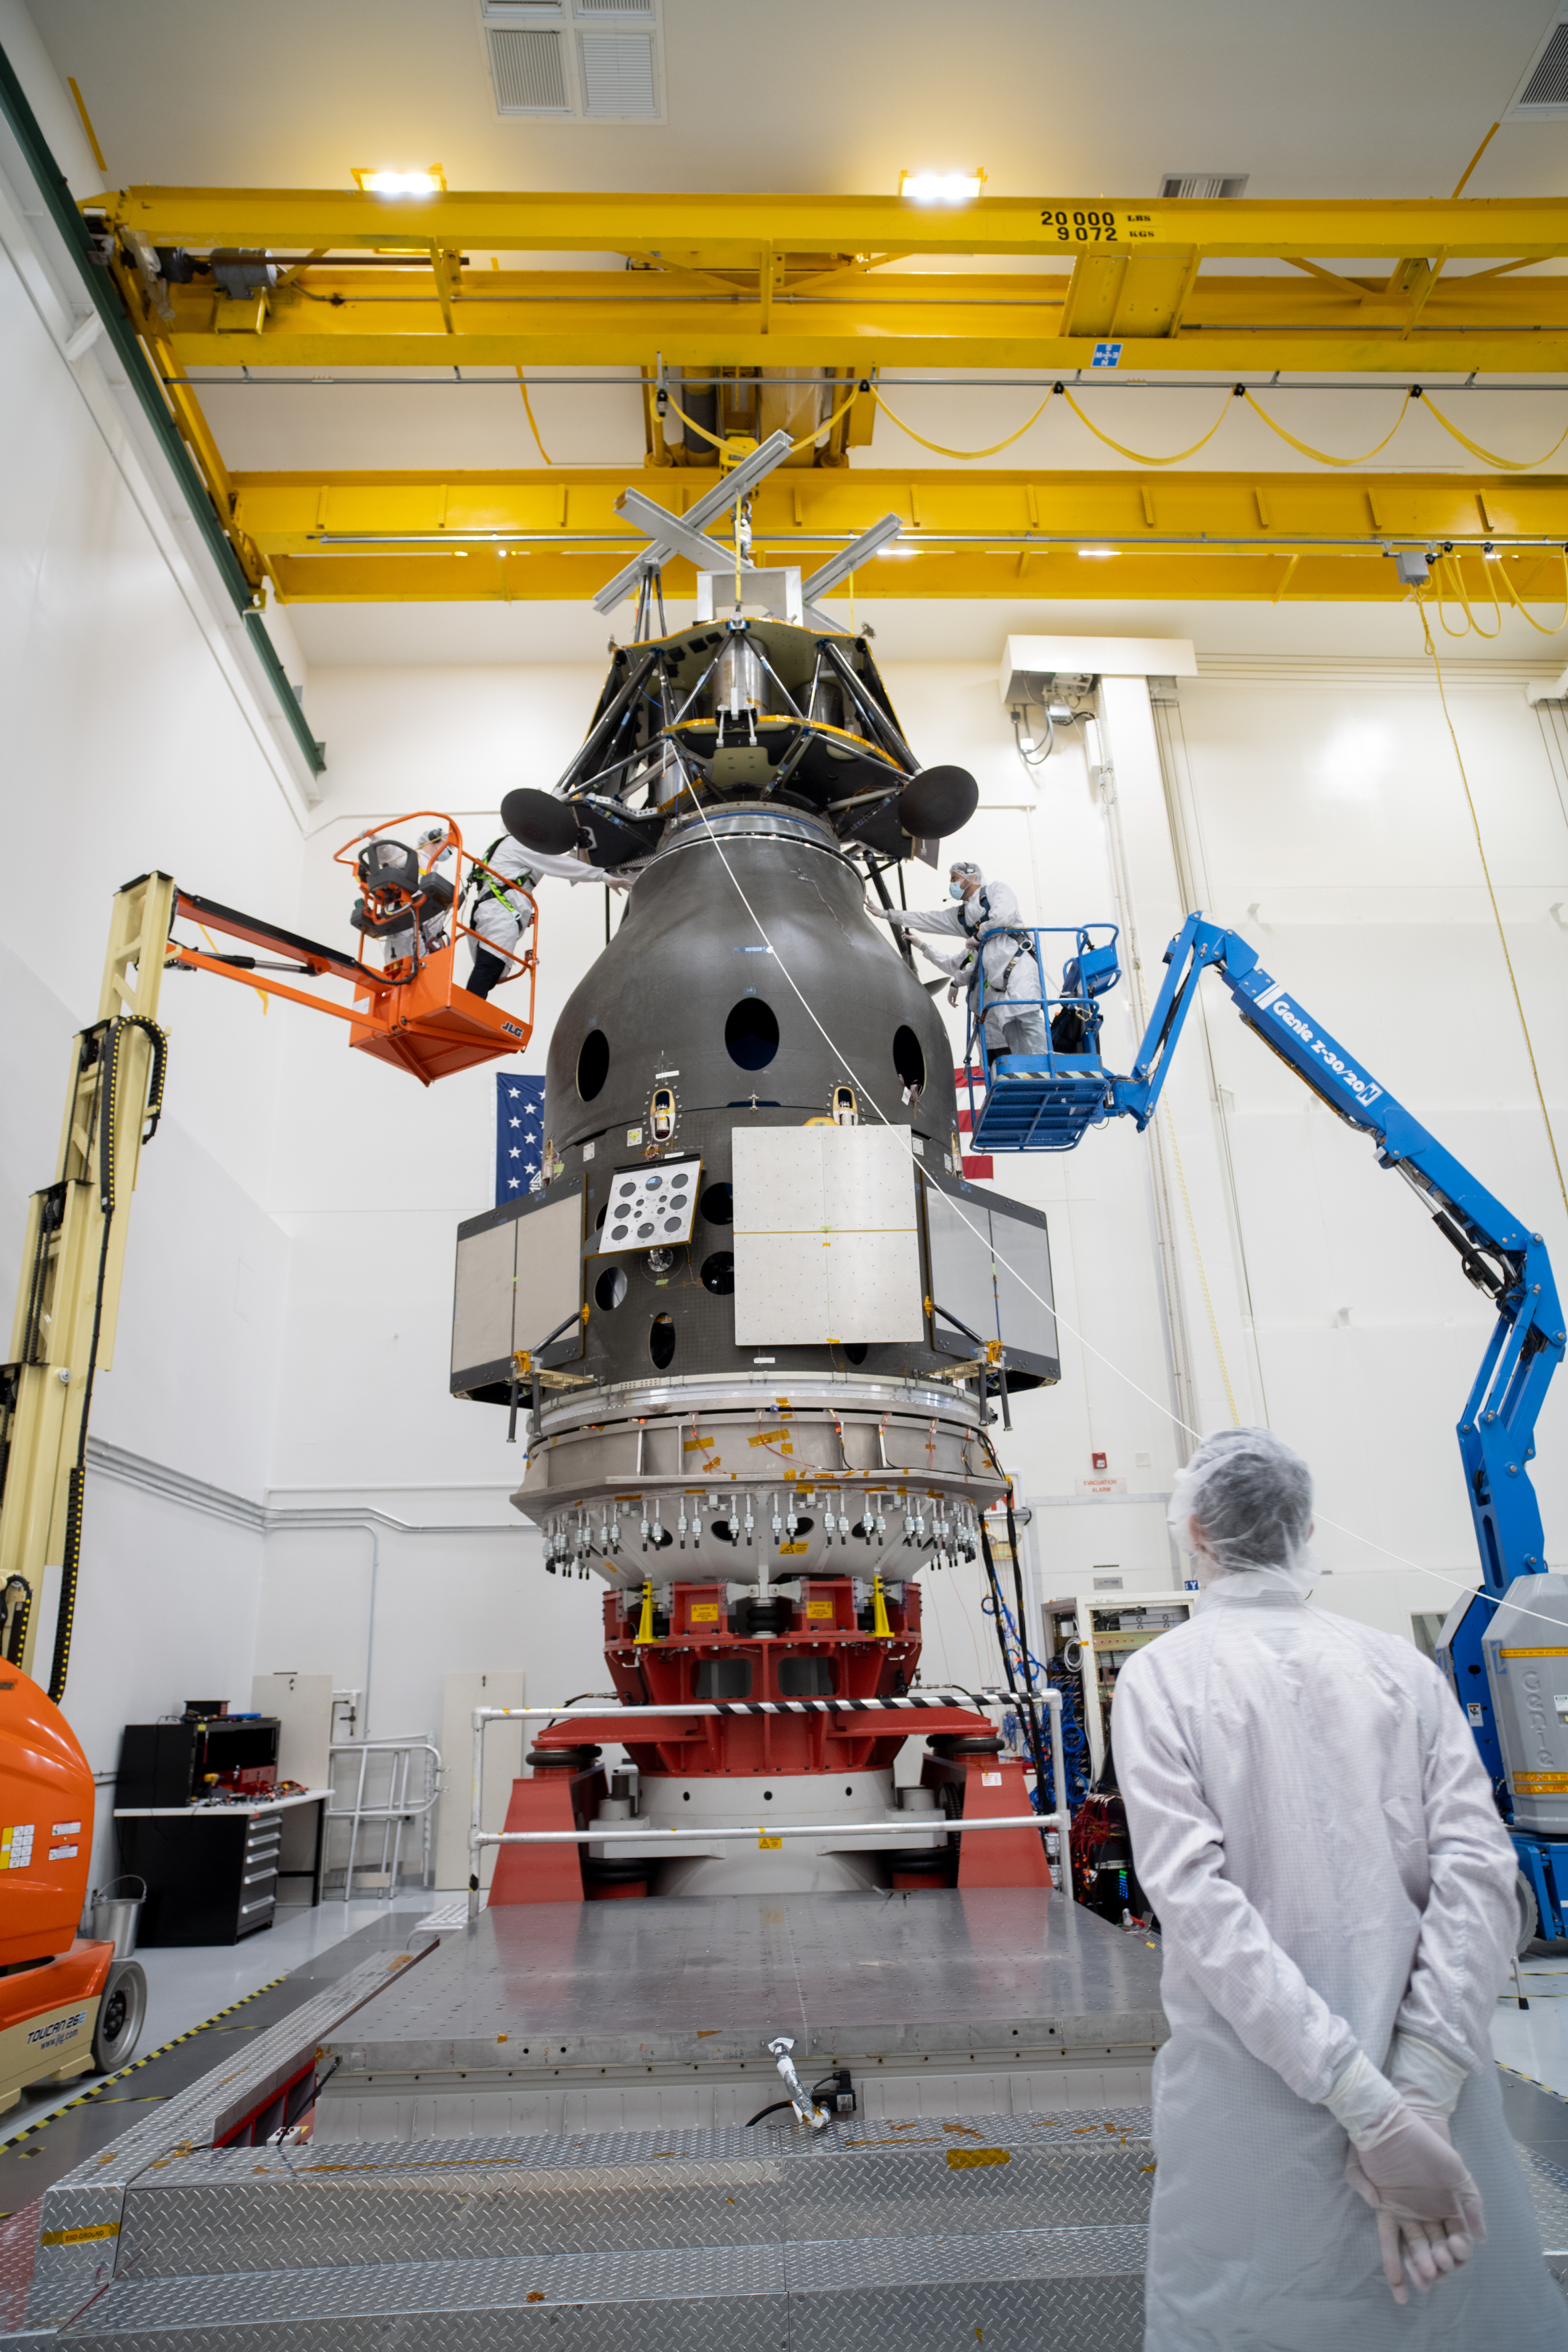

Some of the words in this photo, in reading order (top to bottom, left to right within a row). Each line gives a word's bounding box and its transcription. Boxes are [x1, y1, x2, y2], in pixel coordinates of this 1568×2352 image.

[501, 1021, 524, 1039] JLG
[1273, 1001, 1314, 1042] Genie
[27, 2019, 67, 2045] TOUCAN
[41, 2029, 78, 2050] www.jlg.com
[79, 2230, 104, 2239] GROUND
